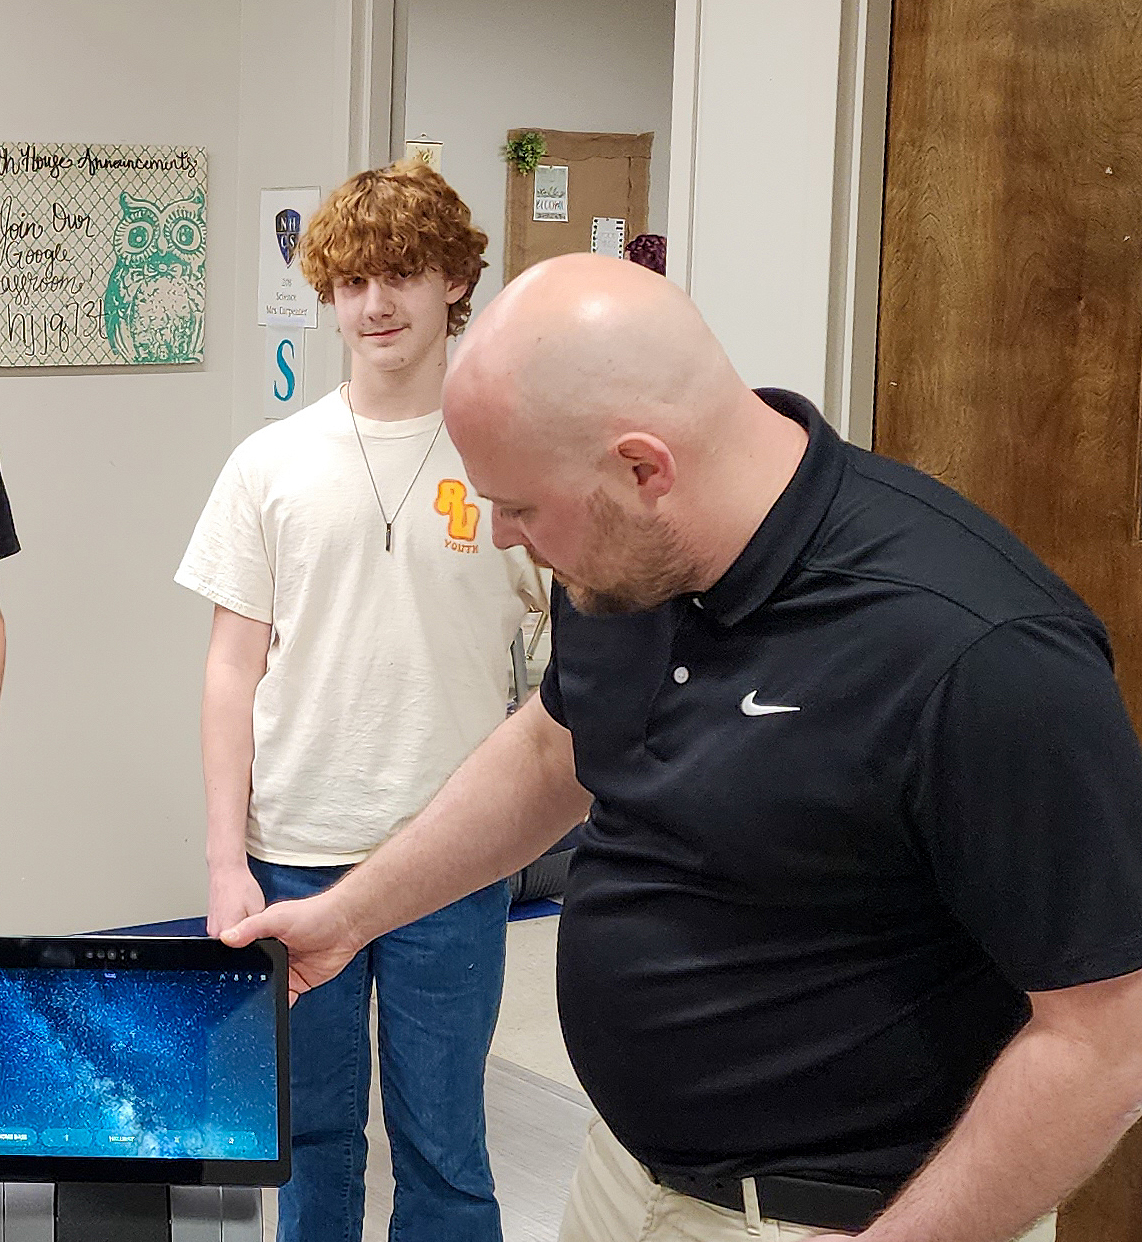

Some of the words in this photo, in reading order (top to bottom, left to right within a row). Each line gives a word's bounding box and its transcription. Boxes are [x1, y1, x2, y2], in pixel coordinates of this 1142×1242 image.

[20, 144, 73, 178] House
[77, 148, 198, 178] Announcements
[52, 202, 95, 237] Our
[280, 216, 296, 231] NH
[280, 234, 296, 248] CS
[5, 241, 75, 279] Google
[274, 339, 295, 402] S
[444, 539, 479, 554] YOUTH
